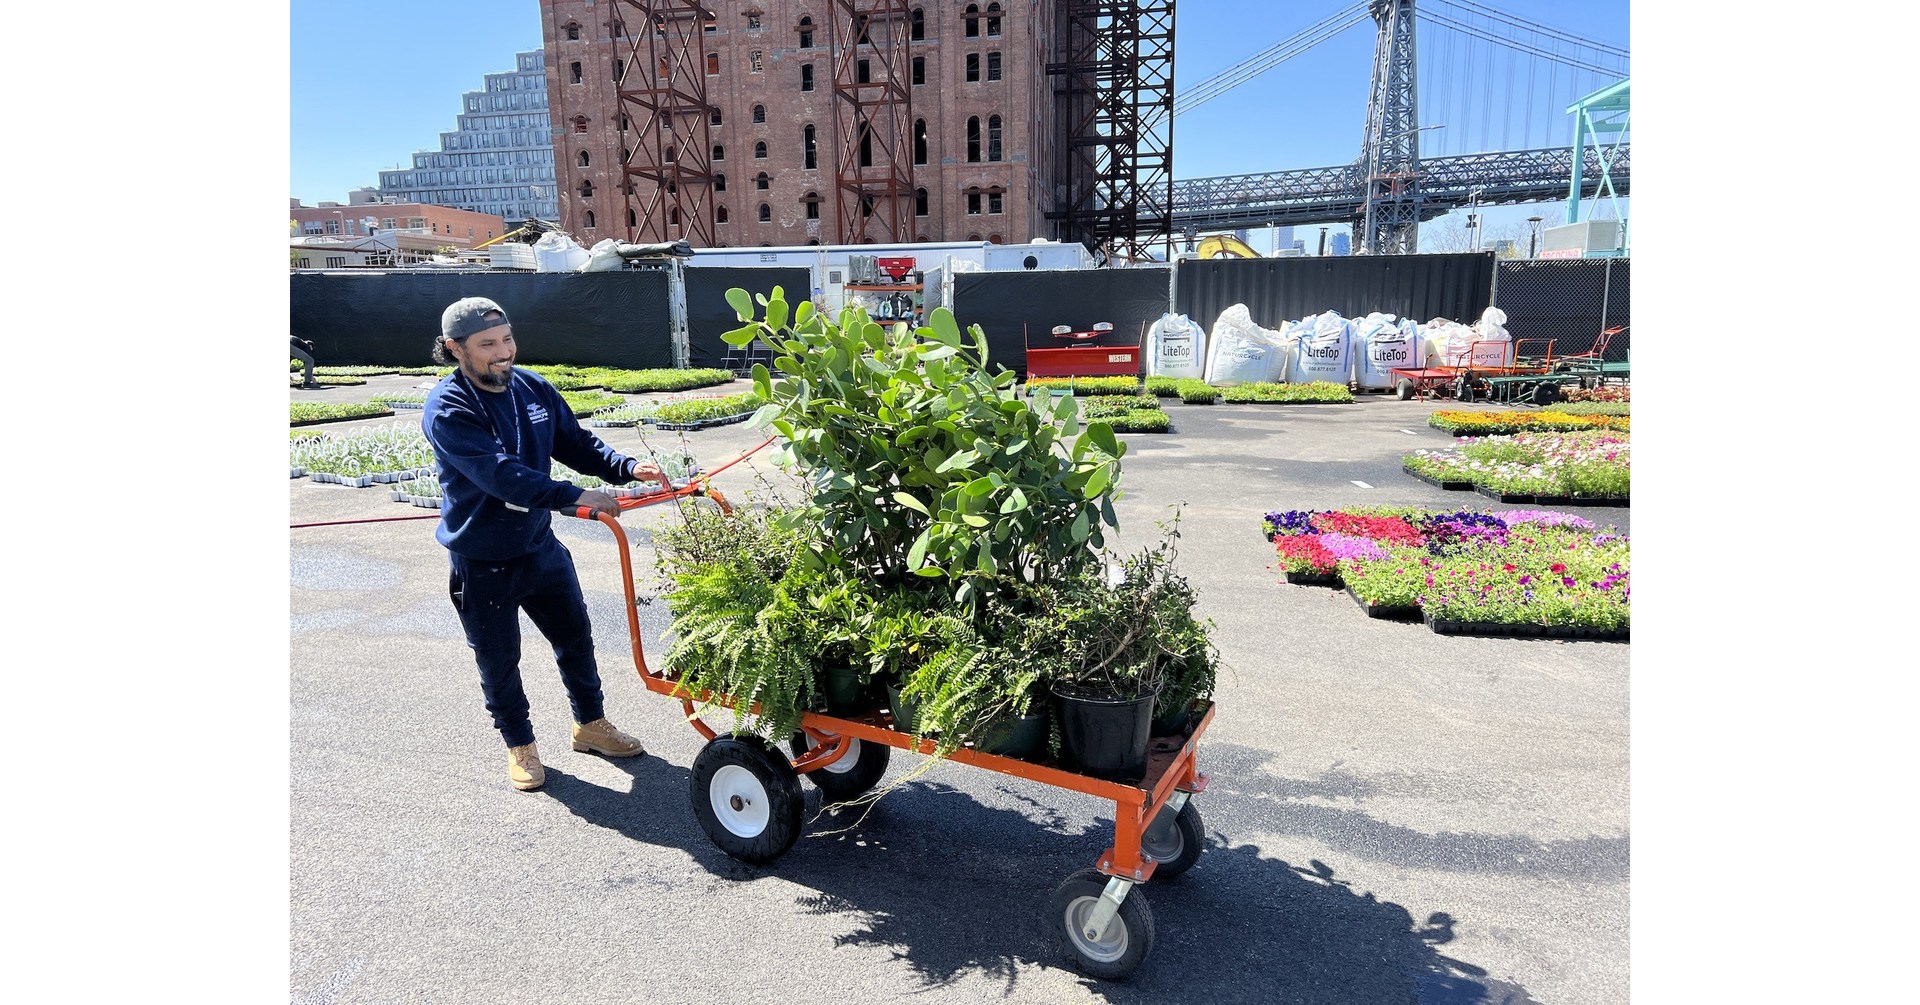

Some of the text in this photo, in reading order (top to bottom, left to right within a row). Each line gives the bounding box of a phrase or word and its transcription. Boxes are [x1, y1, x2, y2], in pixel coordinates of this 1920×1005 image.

[1162, 345, 1190, 358] LiteTop
[1307, 346, 1339, 360] LiteTop
[1374, 349, 1407, 362] LiteTop
